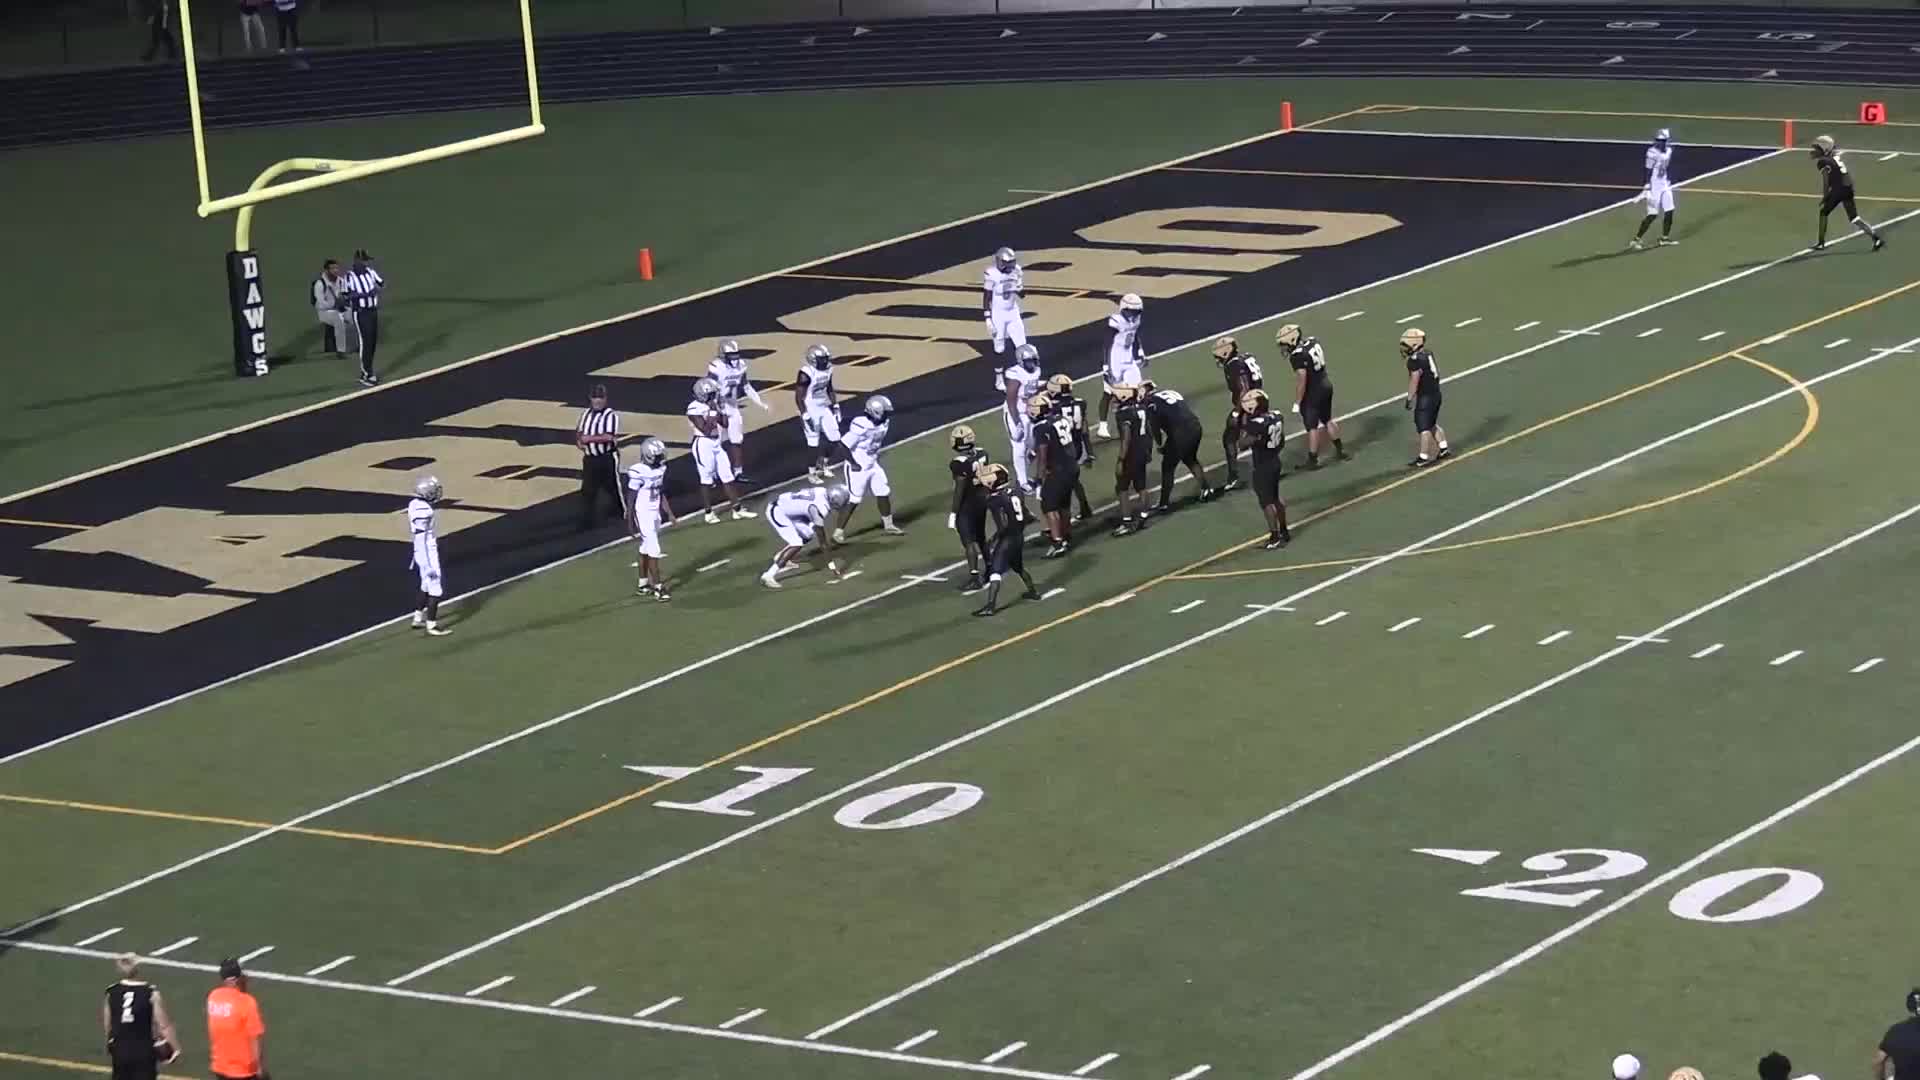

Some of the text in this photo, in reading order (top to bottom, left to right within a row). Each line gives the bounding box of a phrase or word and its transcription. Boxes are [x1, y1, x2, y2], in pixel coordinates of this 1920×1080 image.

[1865, 104, 1879, 122] G
[242, 256, 269, 377] DAWGS
[1137, 409, 1147, 436] 7
[1011, 495, 1024, 522] 9
